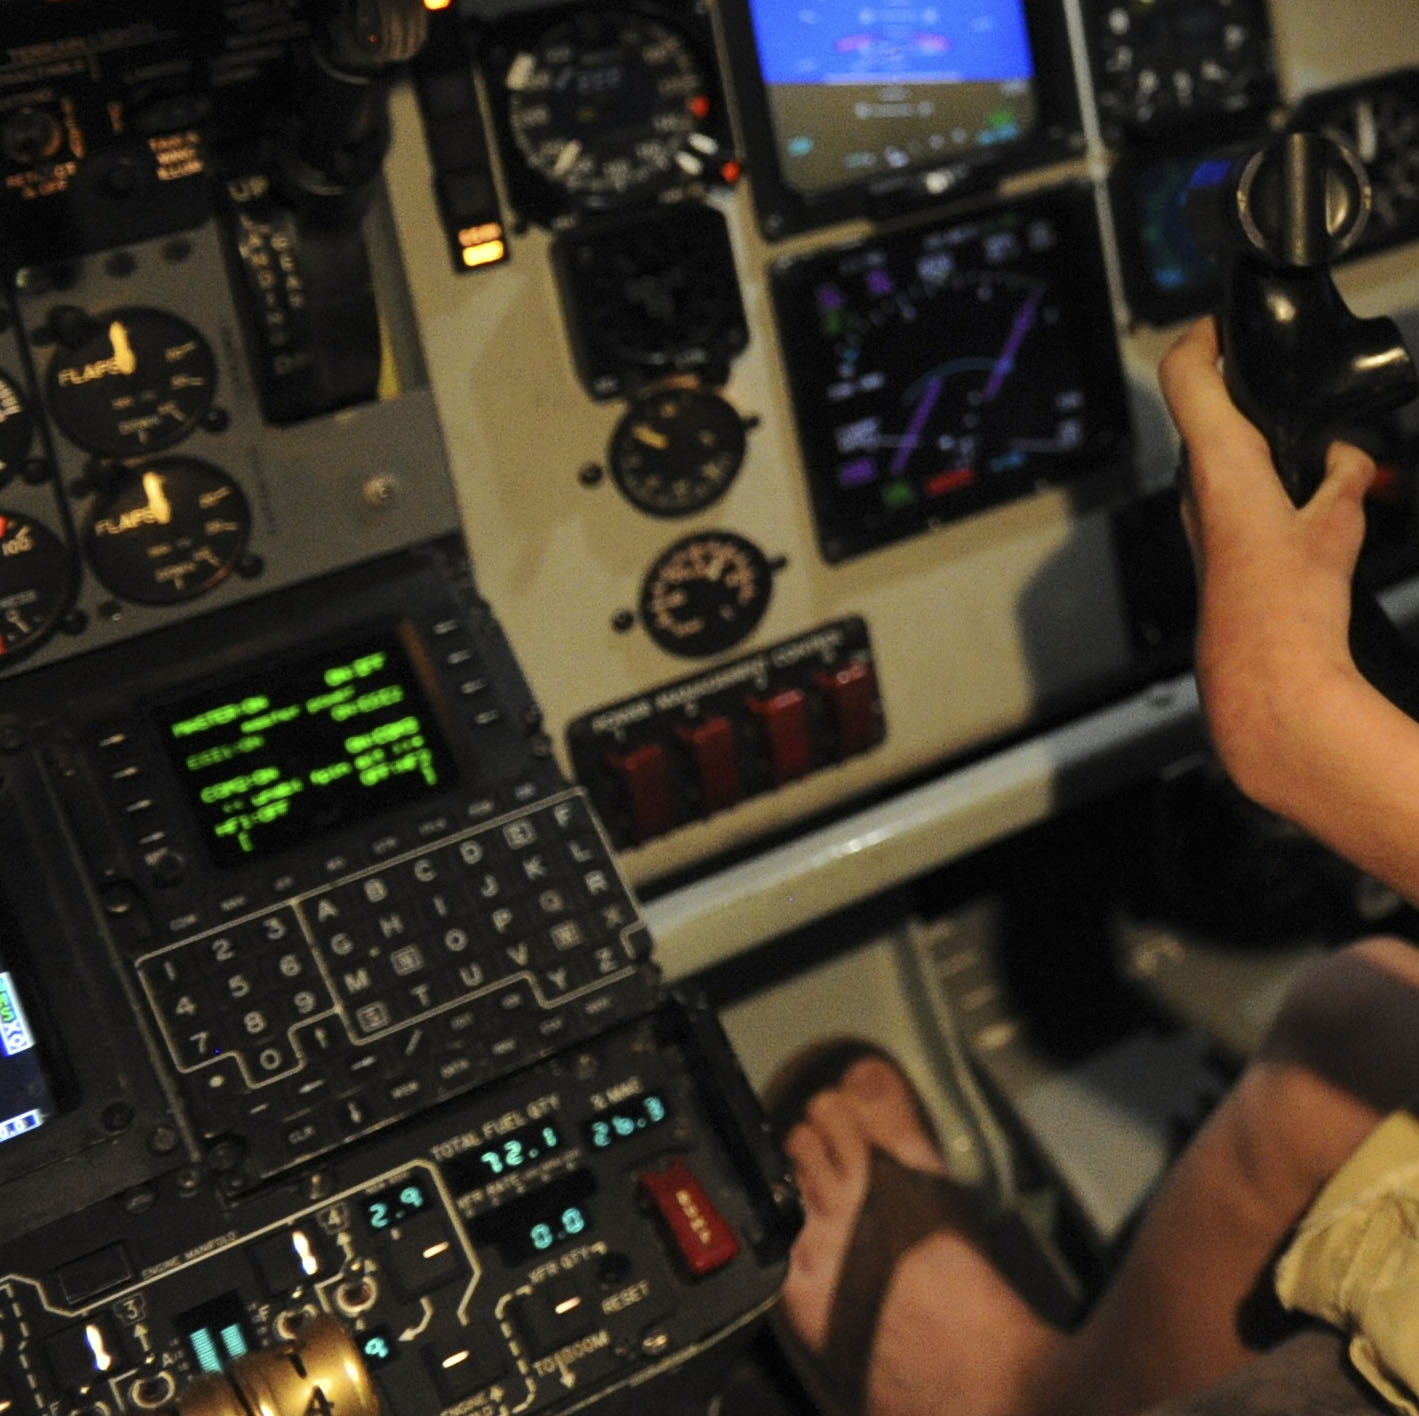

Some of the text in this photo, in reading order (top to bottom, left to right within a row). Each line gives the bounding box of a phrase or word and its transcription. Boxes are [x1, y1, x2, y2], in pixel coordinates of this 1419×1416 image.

[570, 841, 592, 862] L
[414, 859, 436, 882] C
[523, 856, 546, 880] K
[481, 876, 499, 897] J
[318, 899, 338, 921] A
[263, 917, 286, 940] 3
[380, 914, 404, 938] H
[212, 938, 234, 961] 2
[507, 942, 529, 966] V
[163, 961, 176, 980] 1
[279, 954, 301, 977] 6
[459, 963, 484, 987] U
[228, 974, 250, 998] 5
[344, 968, 369, 993] M
[547, 968, 567, 990] Y
[175, 996, 197, 1015] 4
[294, 991, 316, 1014] 9
[411, 984, 430, 1006] T
[243, 1011, 266, 1034] 8
[189, 1031, 209, 1053] 7
[430, 1093, 562, 1162] TOTAL FUEL QTY
[368, 1185, 424, 1230] 2.9
[601, 1280, 650, 1316] RESET
